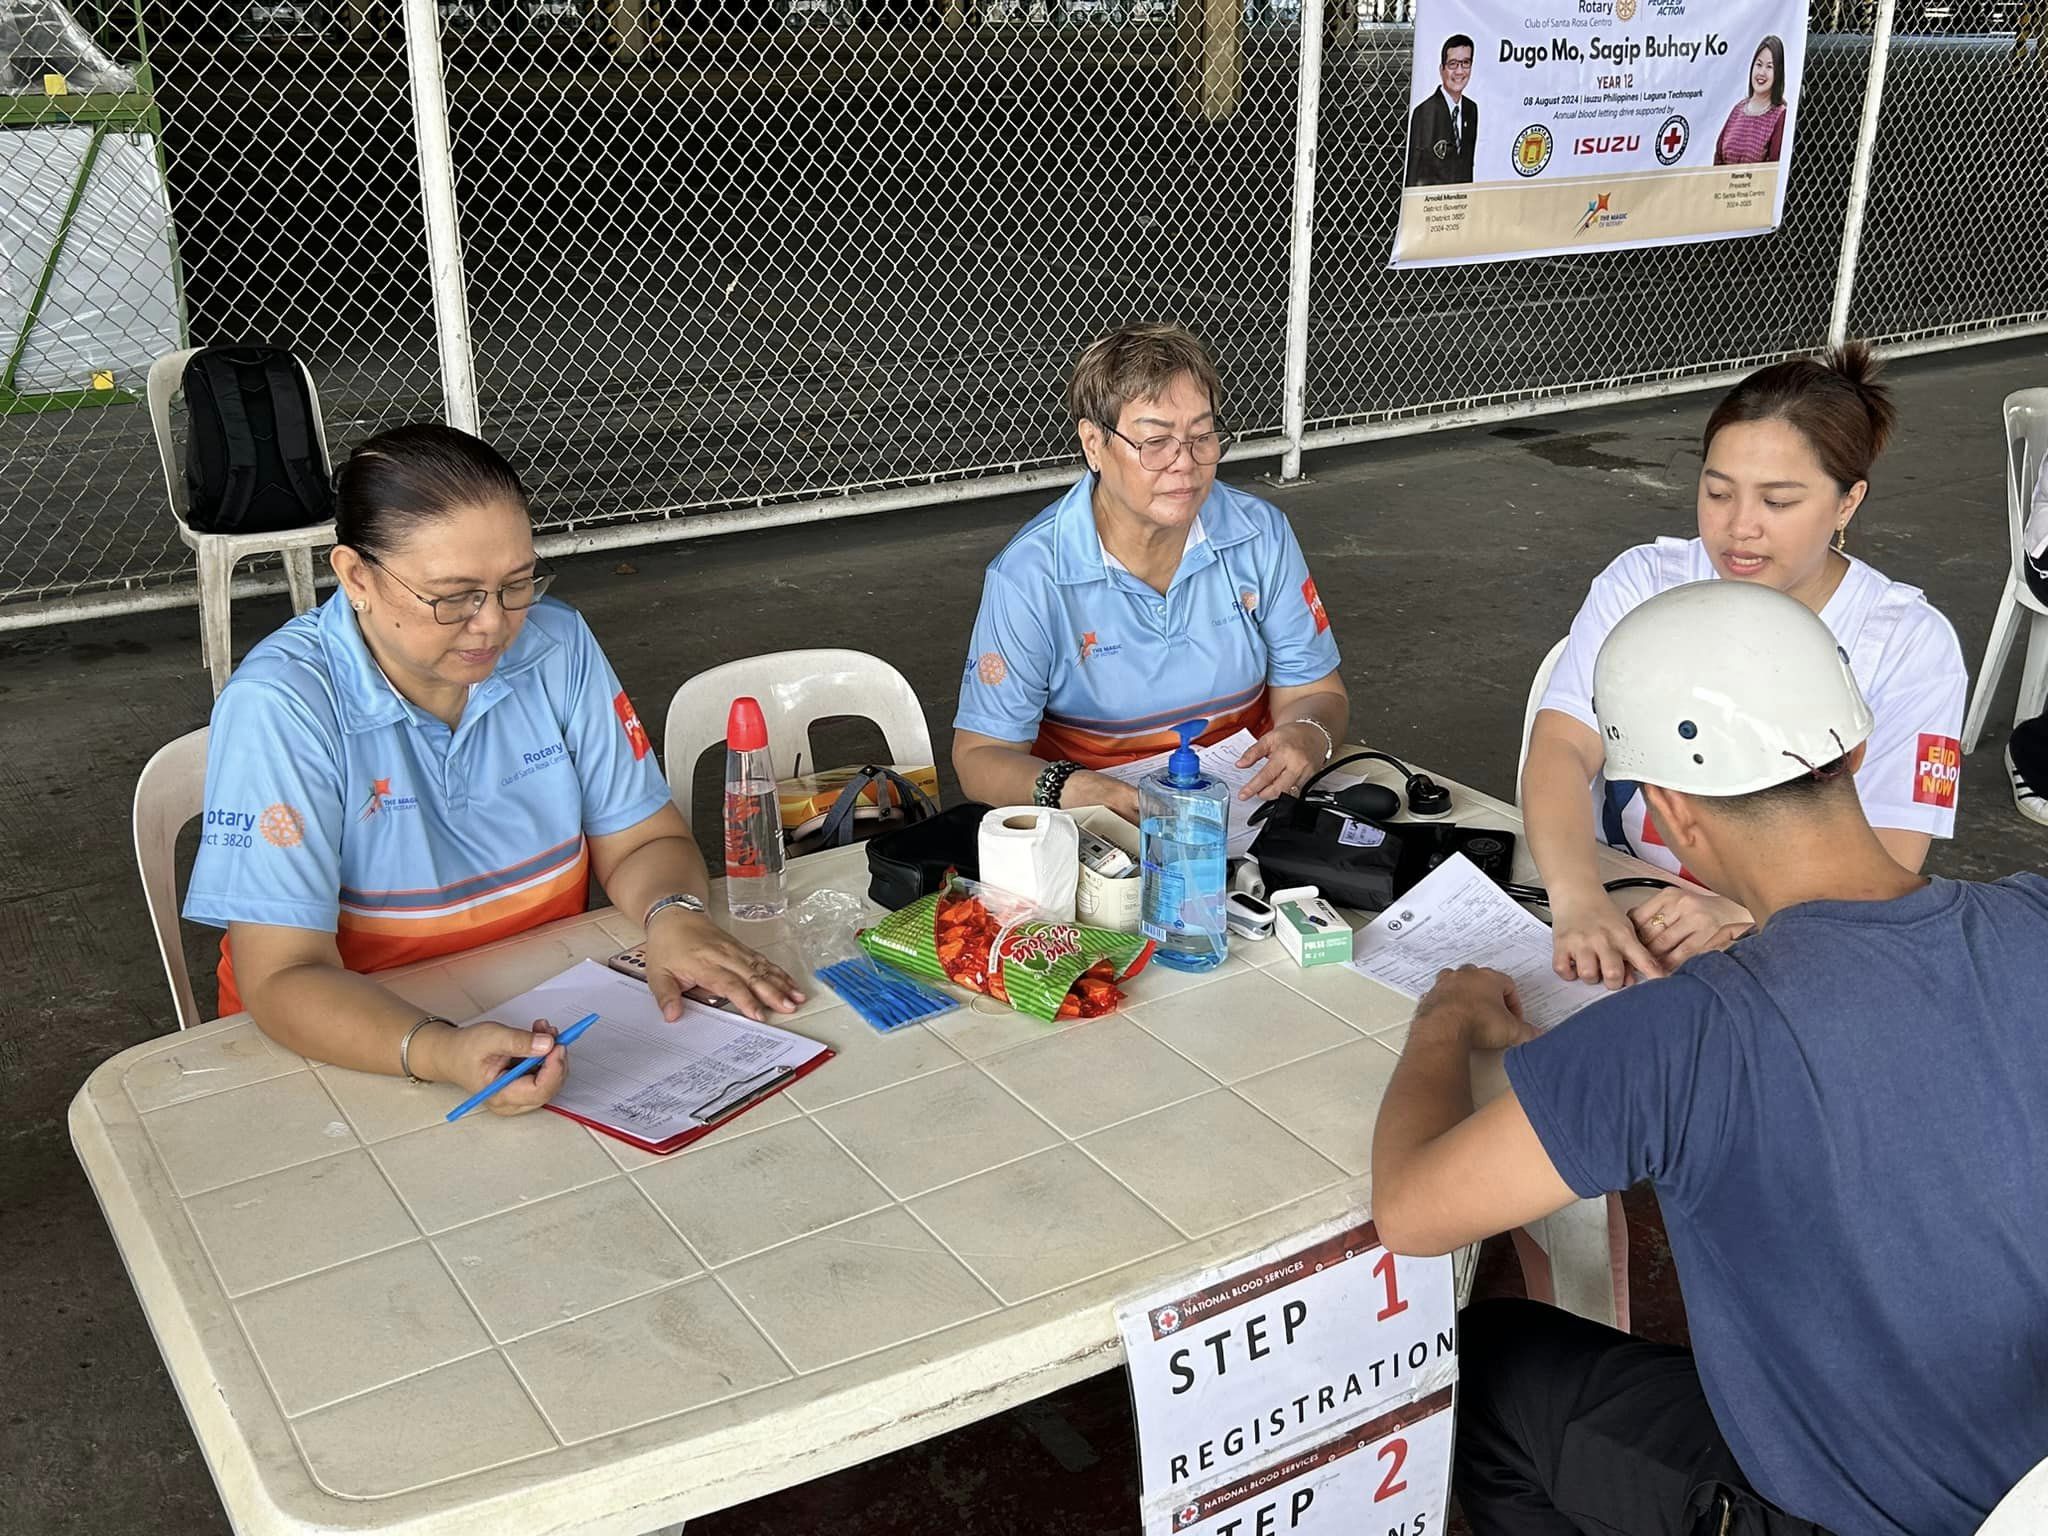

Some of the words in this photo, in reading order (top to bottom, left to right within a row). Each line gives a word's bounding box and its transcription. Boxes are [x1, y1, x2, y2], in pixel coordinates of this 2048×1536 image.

[1578, 0, 1613, 15] Rotary
[1657, 6, 1685, 16] ACTION
[1524, 19, 1541, 29] Club
[1542, 18, 1550, 28] of
[1550, 18, 1570, 28] Santa
[1571, 18, 1588, 28] Rosa
[1589, 17, 1612, 27] Centro
[1499, 38, 1548, 69] Dugo
[1552, 37, 1584, 64] Mo,
[1589, 36, 1641, 66] Sagip
[1645, 34, 1702, 63] Buhay
[1705, 33, 1728, 56] Ko
[1597, 75, 1621, 90] YEAR
[1623, 73, 1633, 88] 12
[1523, 96, 1534, 106] 08
[1535, 95, 1560, 108] August
[1561, 94, 1579, 105] 2024
[1603, 92, 1639, 104] Philippines
[1643, 91, 1667, 103] Laguna
[1668, 89, 1703, 101] Technopark
[1553, 110, 1577, 120] Annual
[1577, 109, 1596, 119] blood
[1598, 108, 1618, 120] letting
[1619, 107, 1635, 117] drive
[1635, 105, 1666, 118] supported
[1666, 104, 1675, 115] by
[1574, 135, 1640, 155] ISUZU
[523, 742, 563, 765] Rotary
[1919, 760, 1957, 781] POLIO
[1922, 775, 1953, 797] NOW
[221, 832, 253, 848] 3820
[1183, 1291, 1231, 1317] NATIONAL
[1231, 1278, 1263, 1297] BLOOD
[1264, 1260, 1304, 1284] SERVICES
[1169, 1299, 1307, 1395] STEP
[1372, 1251, 1408, 1322] 1
[1170, 1327, 1453, 1484] REGISTRATION
[1373, 1438, 1408, 1503] 2
[1204, 1485, 1248, 1510] NATIONAL
[1249, 1470, 1280, 1489] BLOOD
[1281, 1454, 1319, 1478] SERVICES
